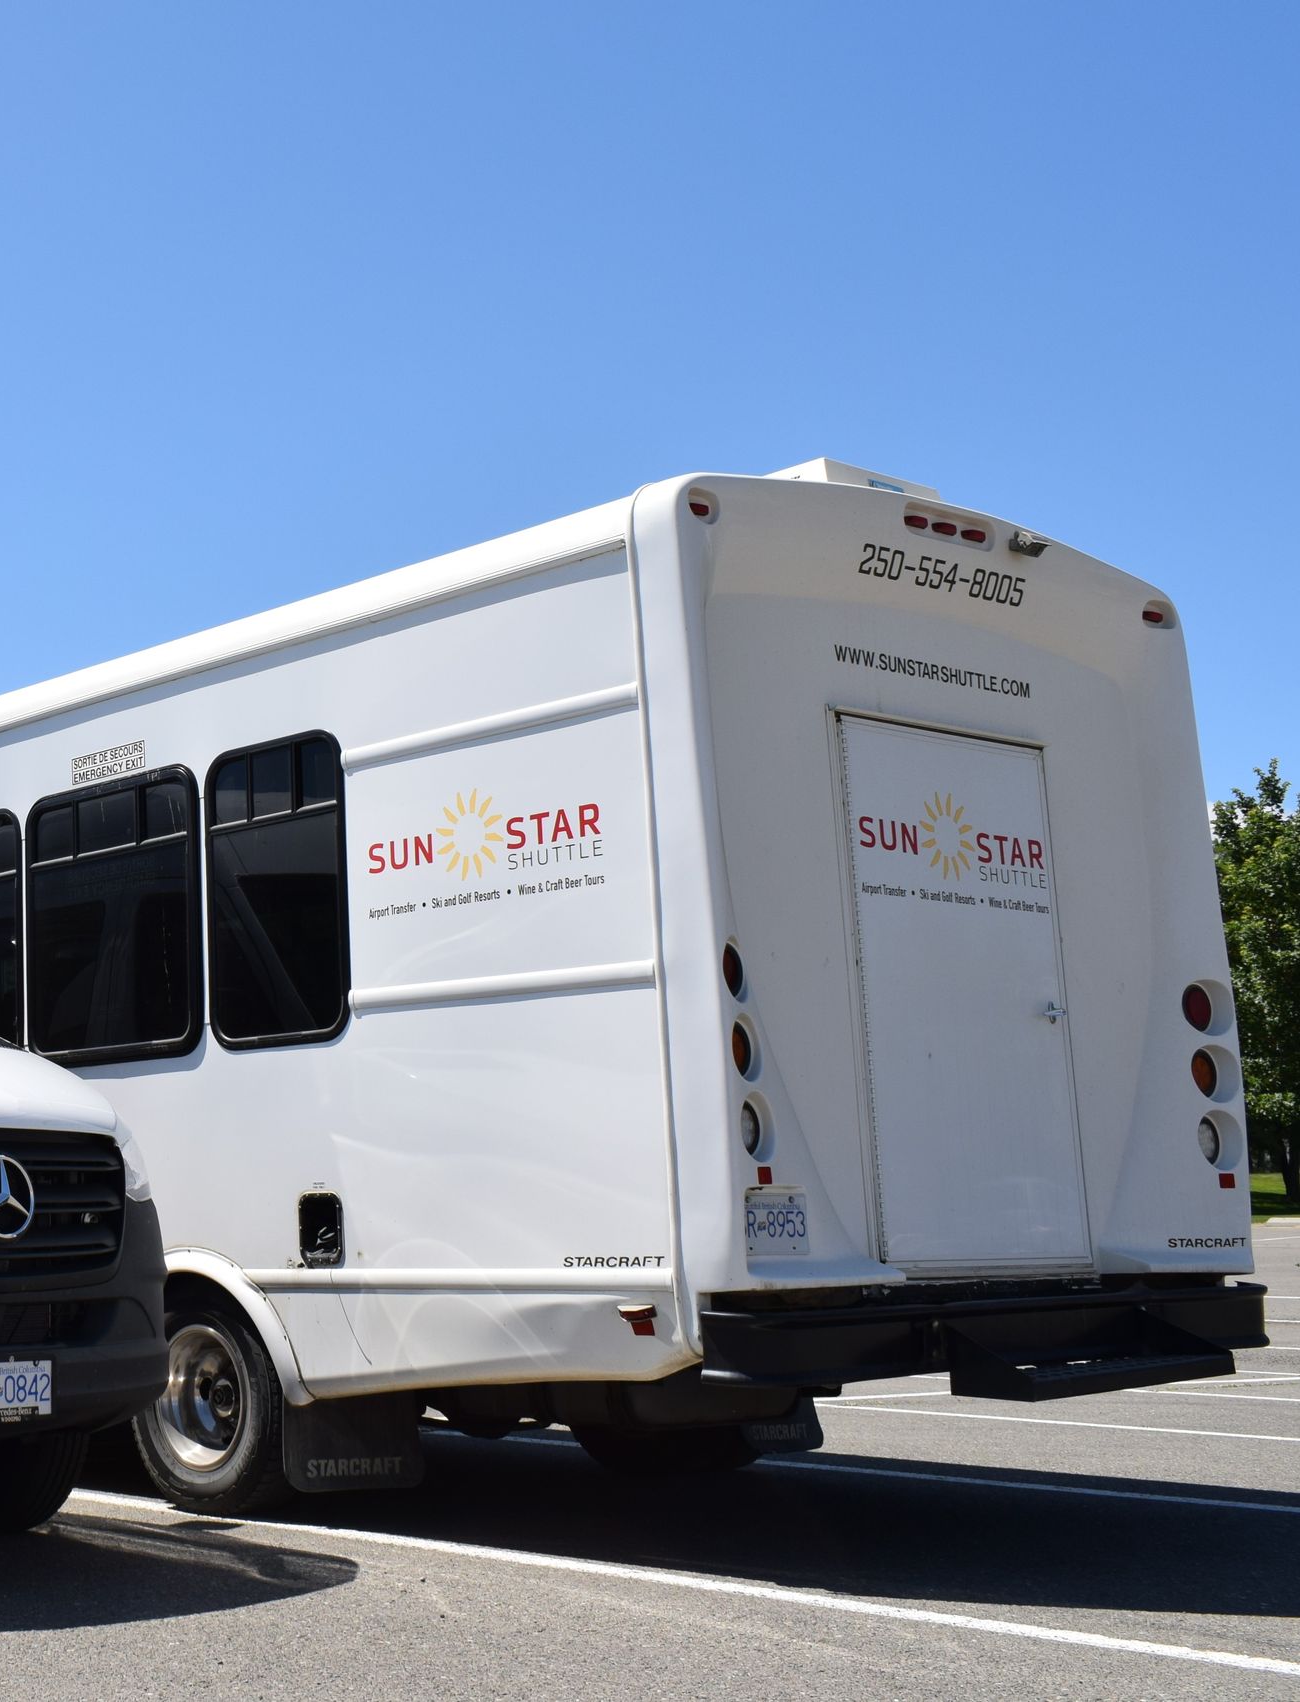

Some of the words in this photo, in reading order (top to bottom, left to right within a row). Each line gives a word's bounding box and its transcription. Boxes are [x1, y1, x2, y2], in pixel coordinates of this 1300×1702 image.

[858, 543, 1026, 607] 250-554-8005
[834, 644, 1031, 698] WWW.SUNSTARSHUTTLE.COM
[73, 755, 97, 769] SORTIE
[99, 752, 108, 763] DE
[110, 743, 143, 760] SECOURS
[74, 762, 124, 783] EMERGENCY
[125, 756, 144, 770] EXIT
[368, 833, 433, 874] SUN
[506, 803, 602, 850] STAR
[859, 816, 919, 856] SUN
[976, 832, 1045, 870] STAR
[508, 839, 604, 870] SHUTTLE
[979, 865, 1047, 889] SHUTTLE
[368, 906, 389, 920] Airport
[390, 901, 417, 915] Transfer
[431, 897, 442, 909] Ski
[444, 895, 457, 907] and
[458, 892, 472, 905] Golf
[474, 889, 501, 903] Resorts
[517, 882, 536, 896] Wine
[538, 882, 544, 894] &
[545, 878, 564, 891] Craft
[565, 876, 582, 889] Beer
[583, 873, 605, 887] Tours
[861, 882, 882, 897] Airport
[883, 884, 907, 897] Transfer
[919, 889, 929, 900] Ski
[930, 890, 941, 902] and
[942, 891, 954, 903] Golf
[955, 893, 976, 906] Resorts
[988, 897, 1002, 909] Wine
[1008, 899, 1022, 911] Craft
[1022, 902, 1034, 912] Beer
[1034, 903, 1049, 914] Tours
[767, 1211, 806, 1238] 8953
[1168, 1237, 1246, 1248] STARCRAFT
[563, 1255, 665, 1268] STARCRAFT
[0, 1367, 18, 1375] British
[19, 1365, 45, 1374] Columbia
[4, 1373, 50, 1403] 0842
[306, 1456, 403, 1479] STARCRAFT
